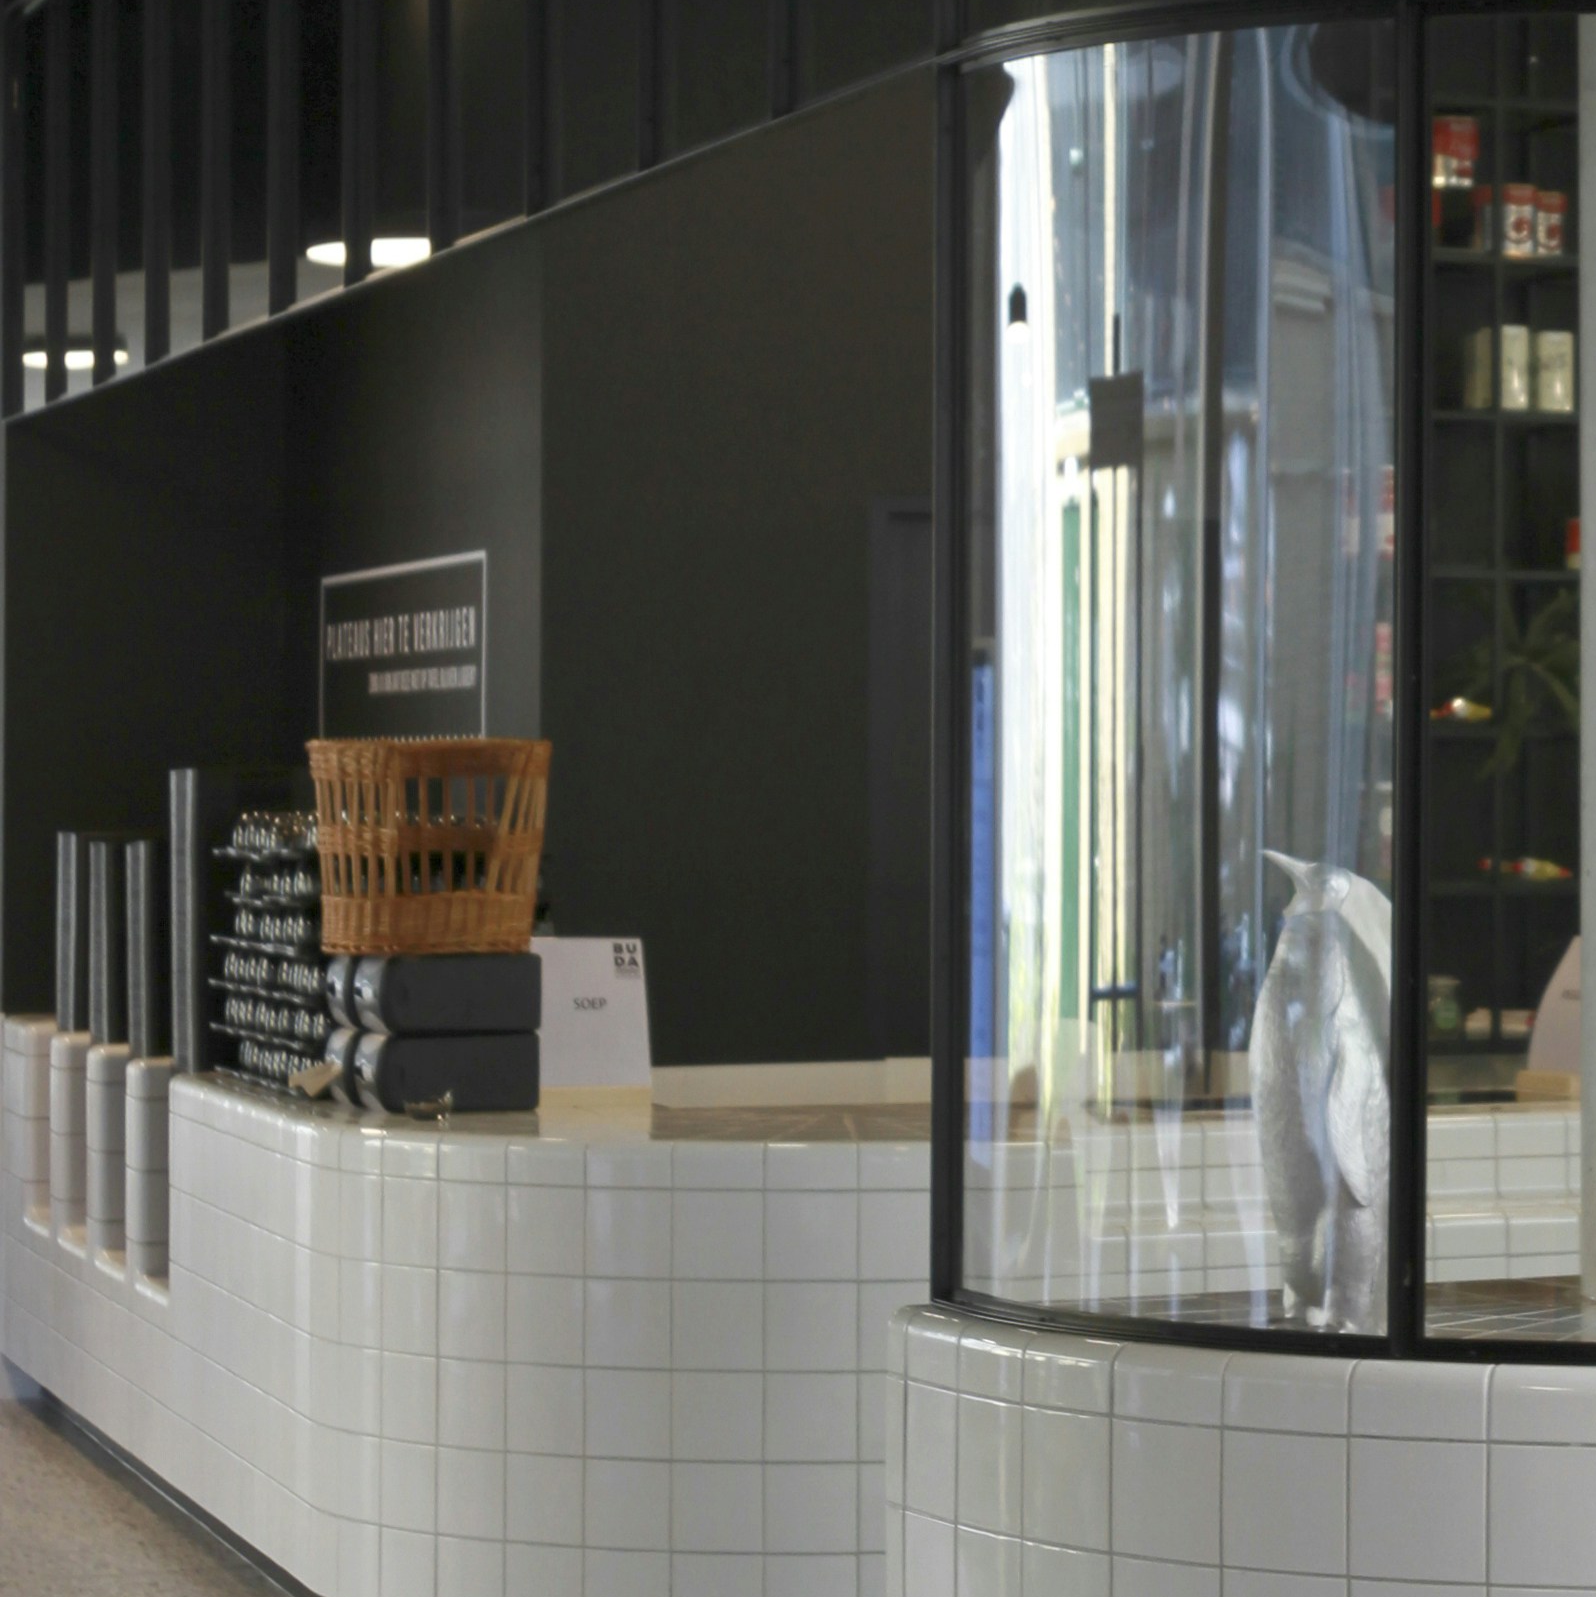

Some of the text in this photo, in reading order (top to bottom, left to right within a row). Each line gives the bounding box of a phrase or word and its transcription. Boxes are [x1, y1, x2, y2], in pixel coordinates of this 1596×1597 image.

[327, 606, 475, 660] PLATEAUS HIER TE VERKRIJGEN
[573, 997, 607, 1010] SOEP
